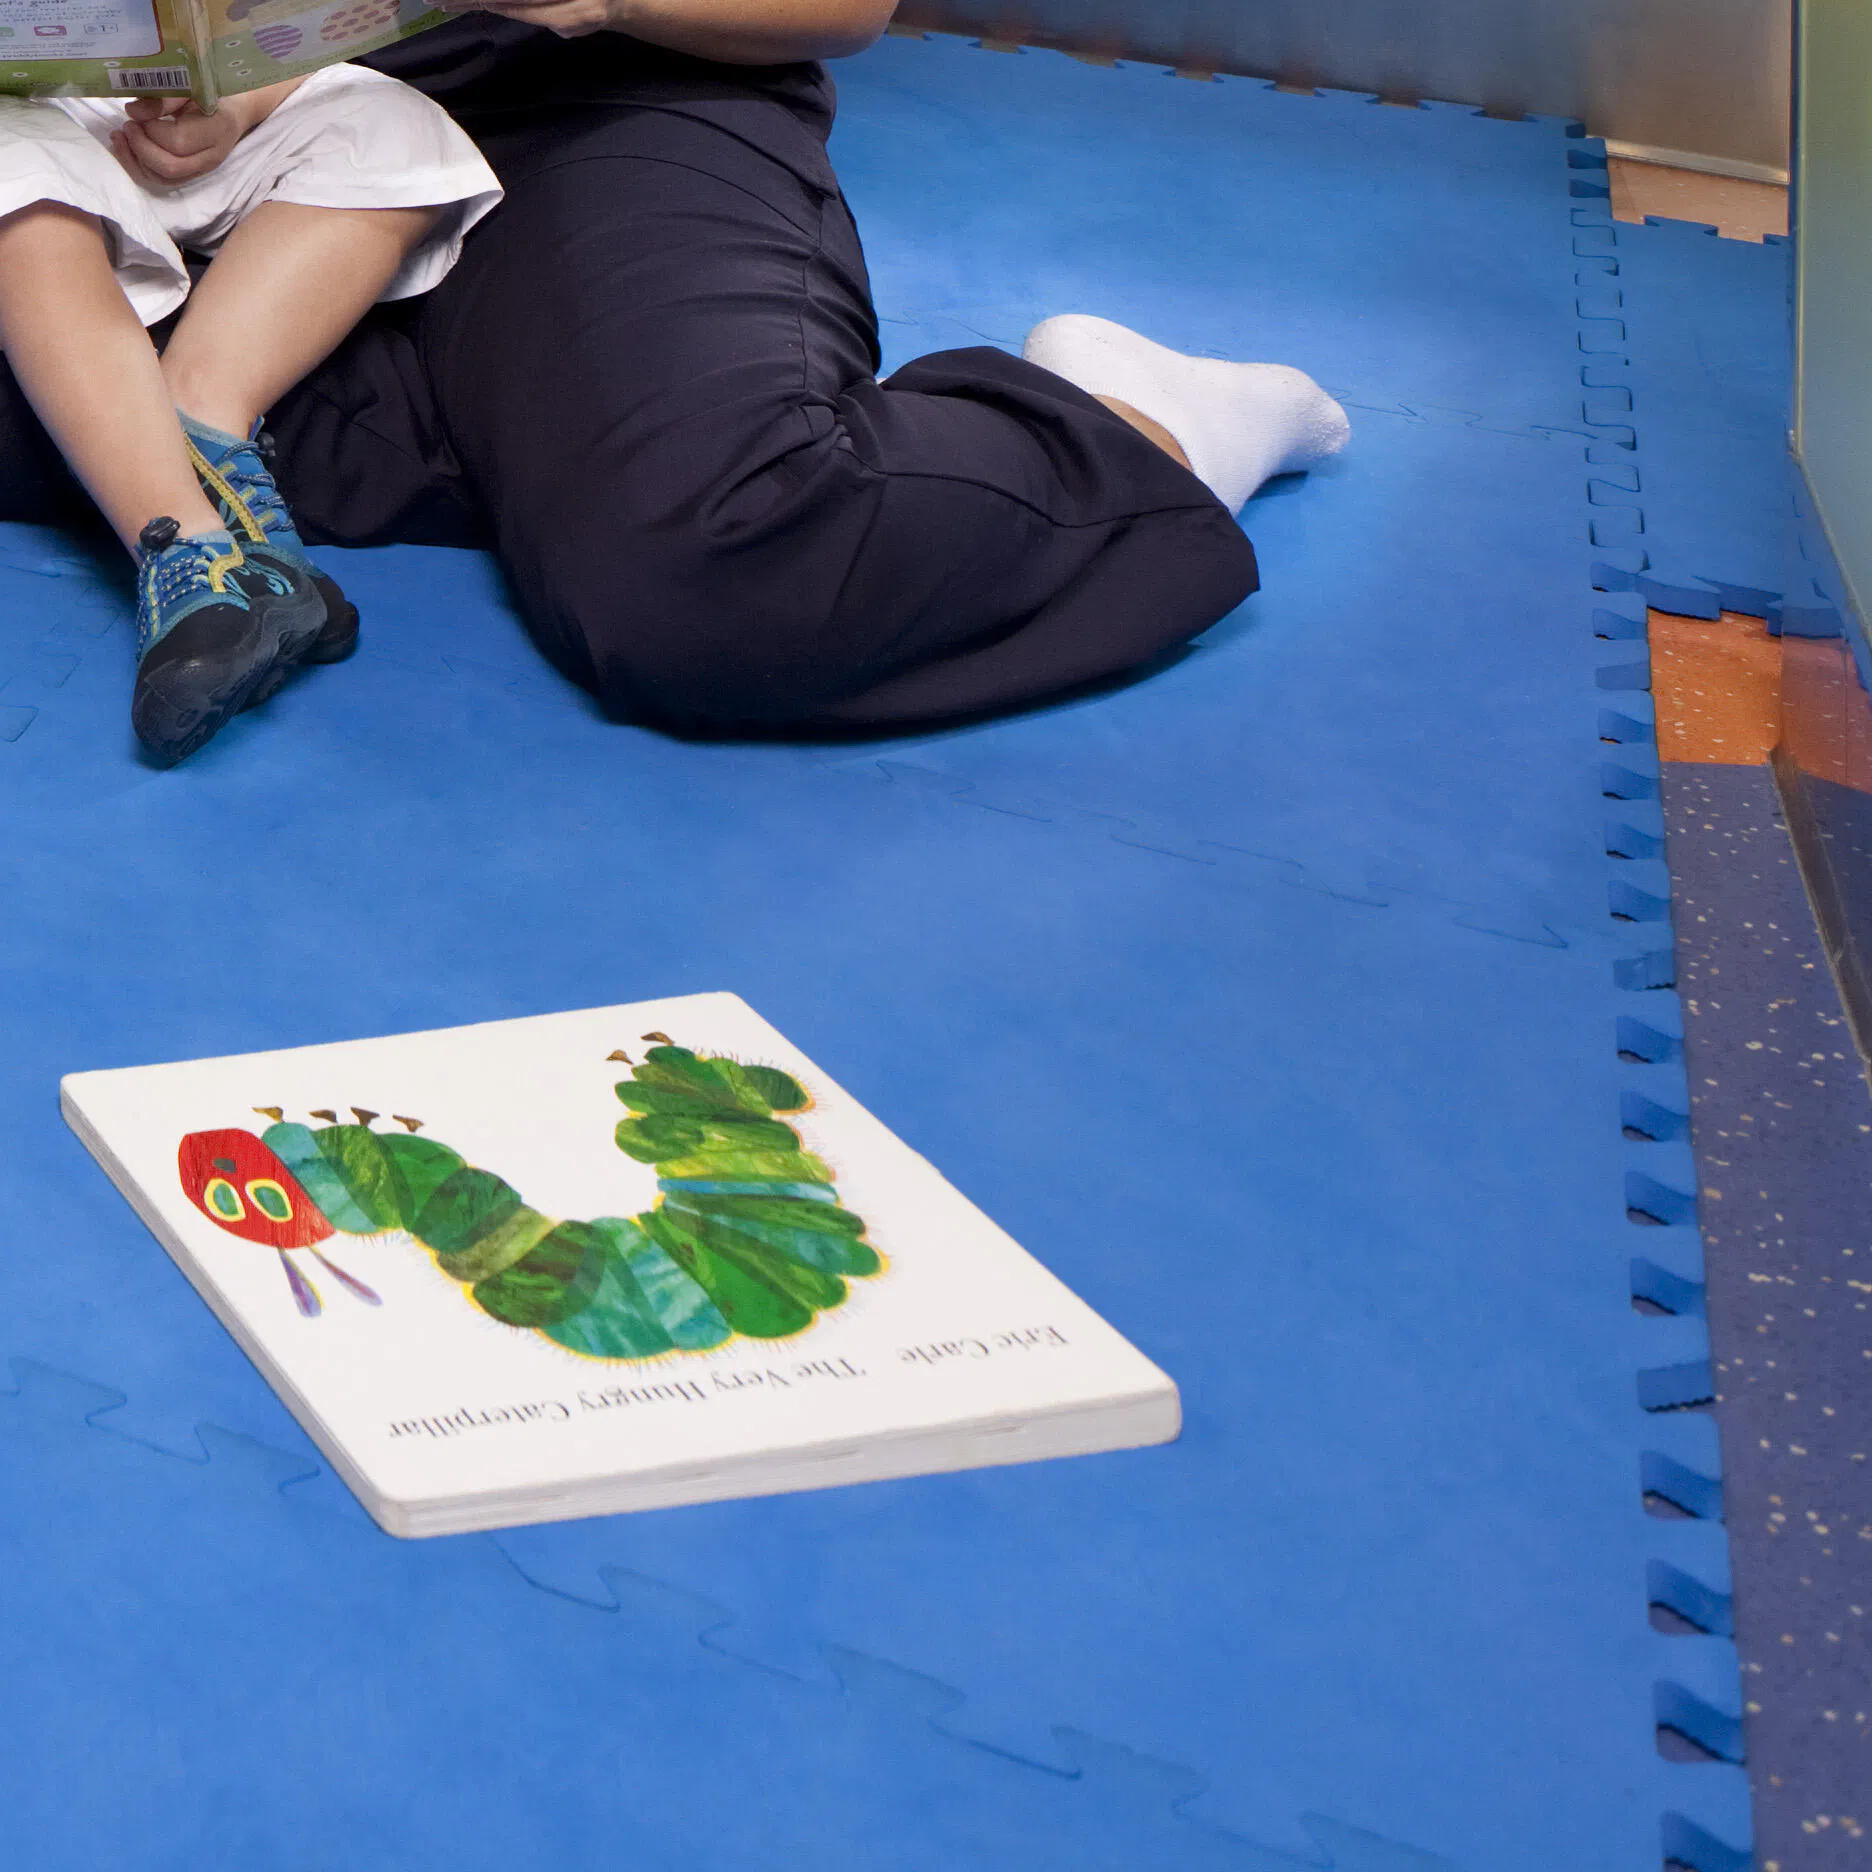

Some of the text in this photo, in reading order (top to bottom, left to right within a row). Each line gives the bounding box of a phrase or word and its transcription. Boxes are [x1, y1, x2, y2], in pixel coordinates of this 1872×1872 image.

[388, 1323, 1069, 1443] Eric Carle The Very Hungry Caterpillar
